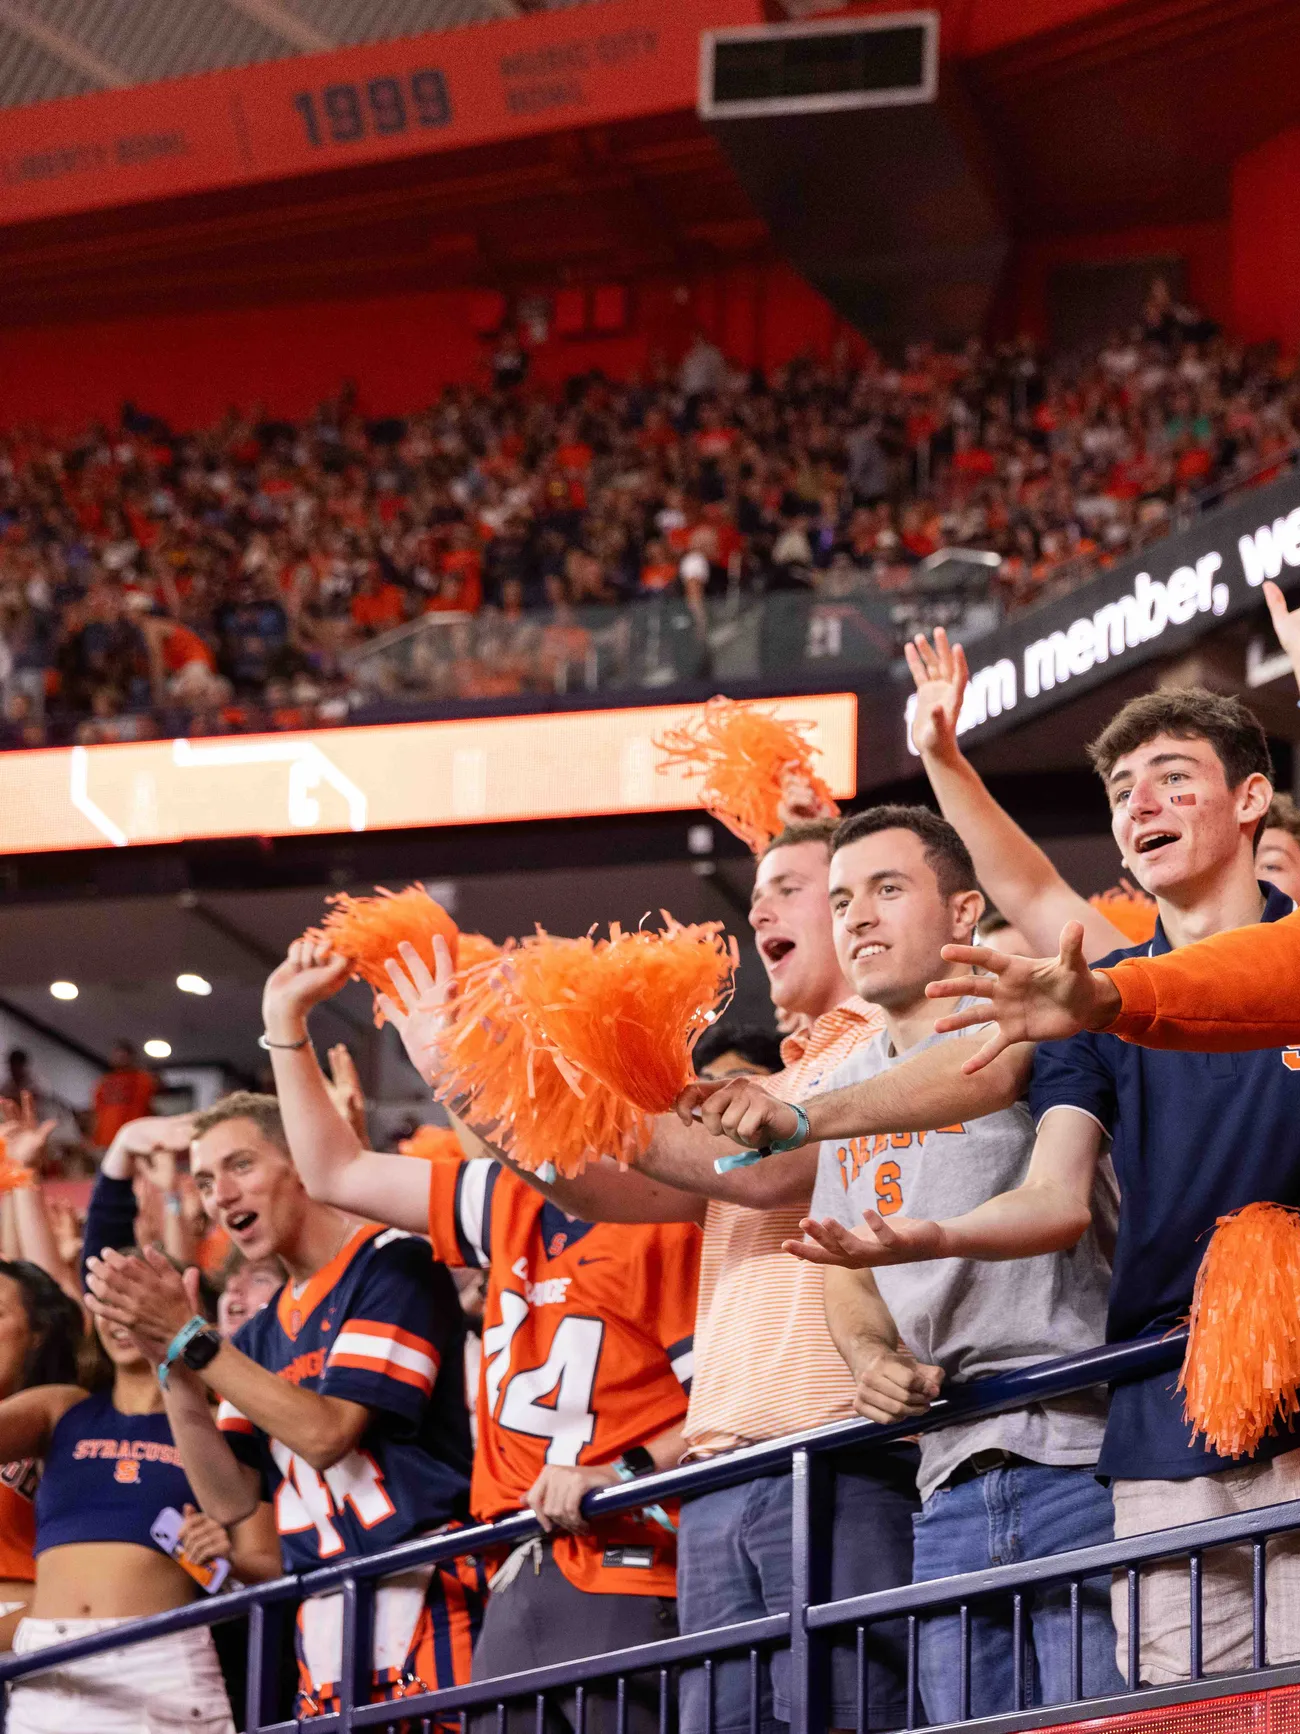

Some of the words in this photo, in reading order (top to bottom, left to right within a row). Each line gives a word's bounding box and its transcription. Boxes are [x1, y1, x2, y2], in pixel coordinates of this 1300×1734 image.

[295, 67, 453, 147] 1999
[1024, 551, 1229, 698] member,
[874, 1160, 904, 1217] S
[548, 1232, 568, 1256] S
[114, 1459, 141, 1484] S
